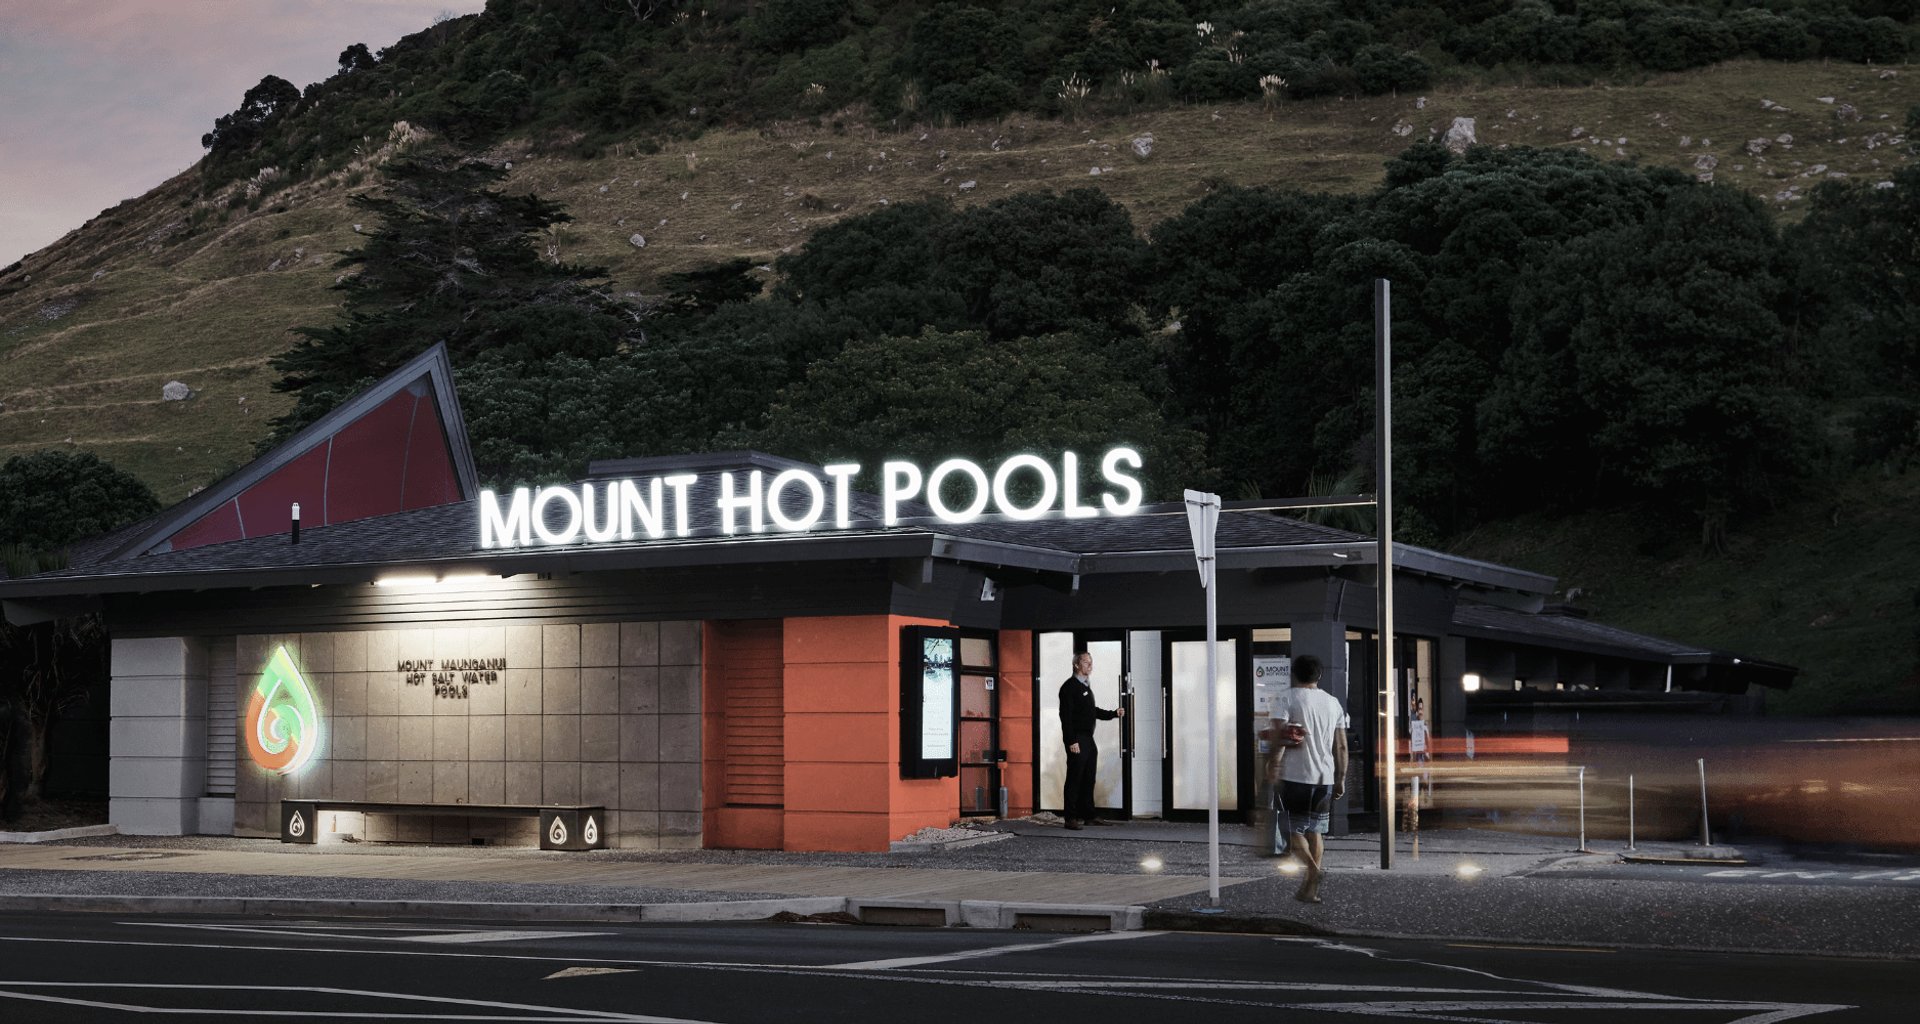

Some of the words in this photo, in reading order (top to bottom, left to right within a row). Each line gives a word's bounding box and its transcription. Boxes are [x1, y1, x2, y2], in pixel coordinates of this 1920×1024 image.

[480, 474, 698, 549] MOUNT
[717, 464, 861, 534] HOT
[882, 446, 1144, 526] POOLS
[398, 659, 434, 672] MOUNT
[441, 657, 506, 671] MAUNGANUI
[406, 673, 426, 686] HOT
[432, 671, 455, 686] SALT
[462, 670, 498, 685] WATER
[435, 684, 468, 699] POOLS
